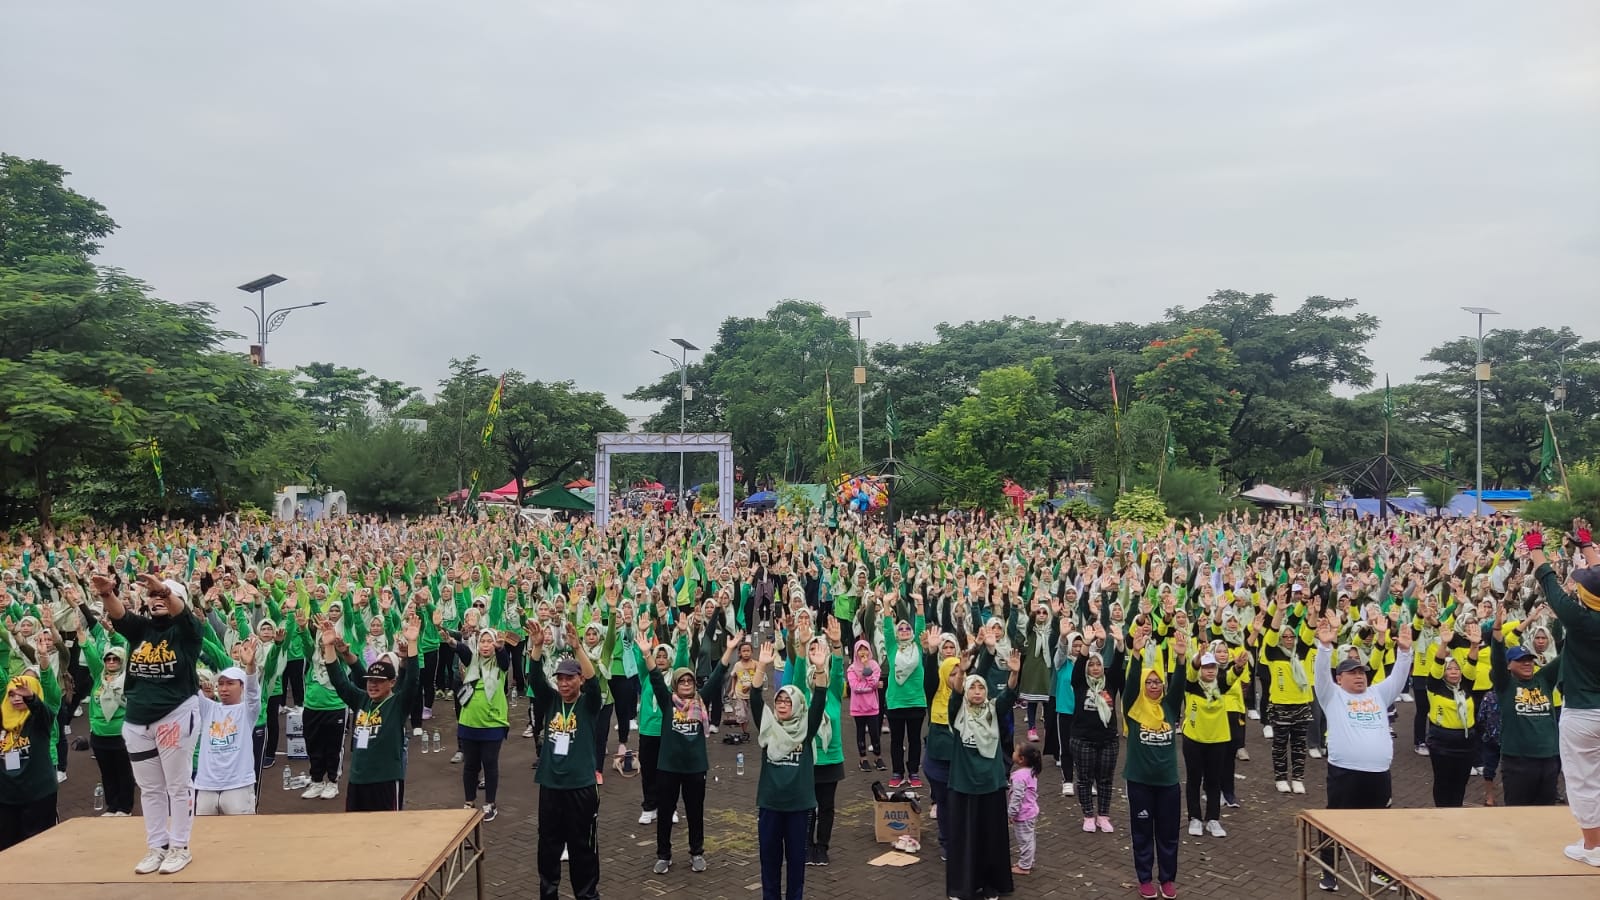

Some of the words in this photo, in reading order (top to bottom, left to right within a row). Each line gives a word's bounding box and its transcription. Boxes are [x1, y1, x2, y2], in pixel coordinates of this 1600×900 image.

[130, 649, 177, 663] SENAM
[129, 660, 178, 674] GESIT
[1515, 702, 1551, 713] GESIT
[1139, 730, 1174, 742] GESIT
[884, 810, 909, 820] AQUA
